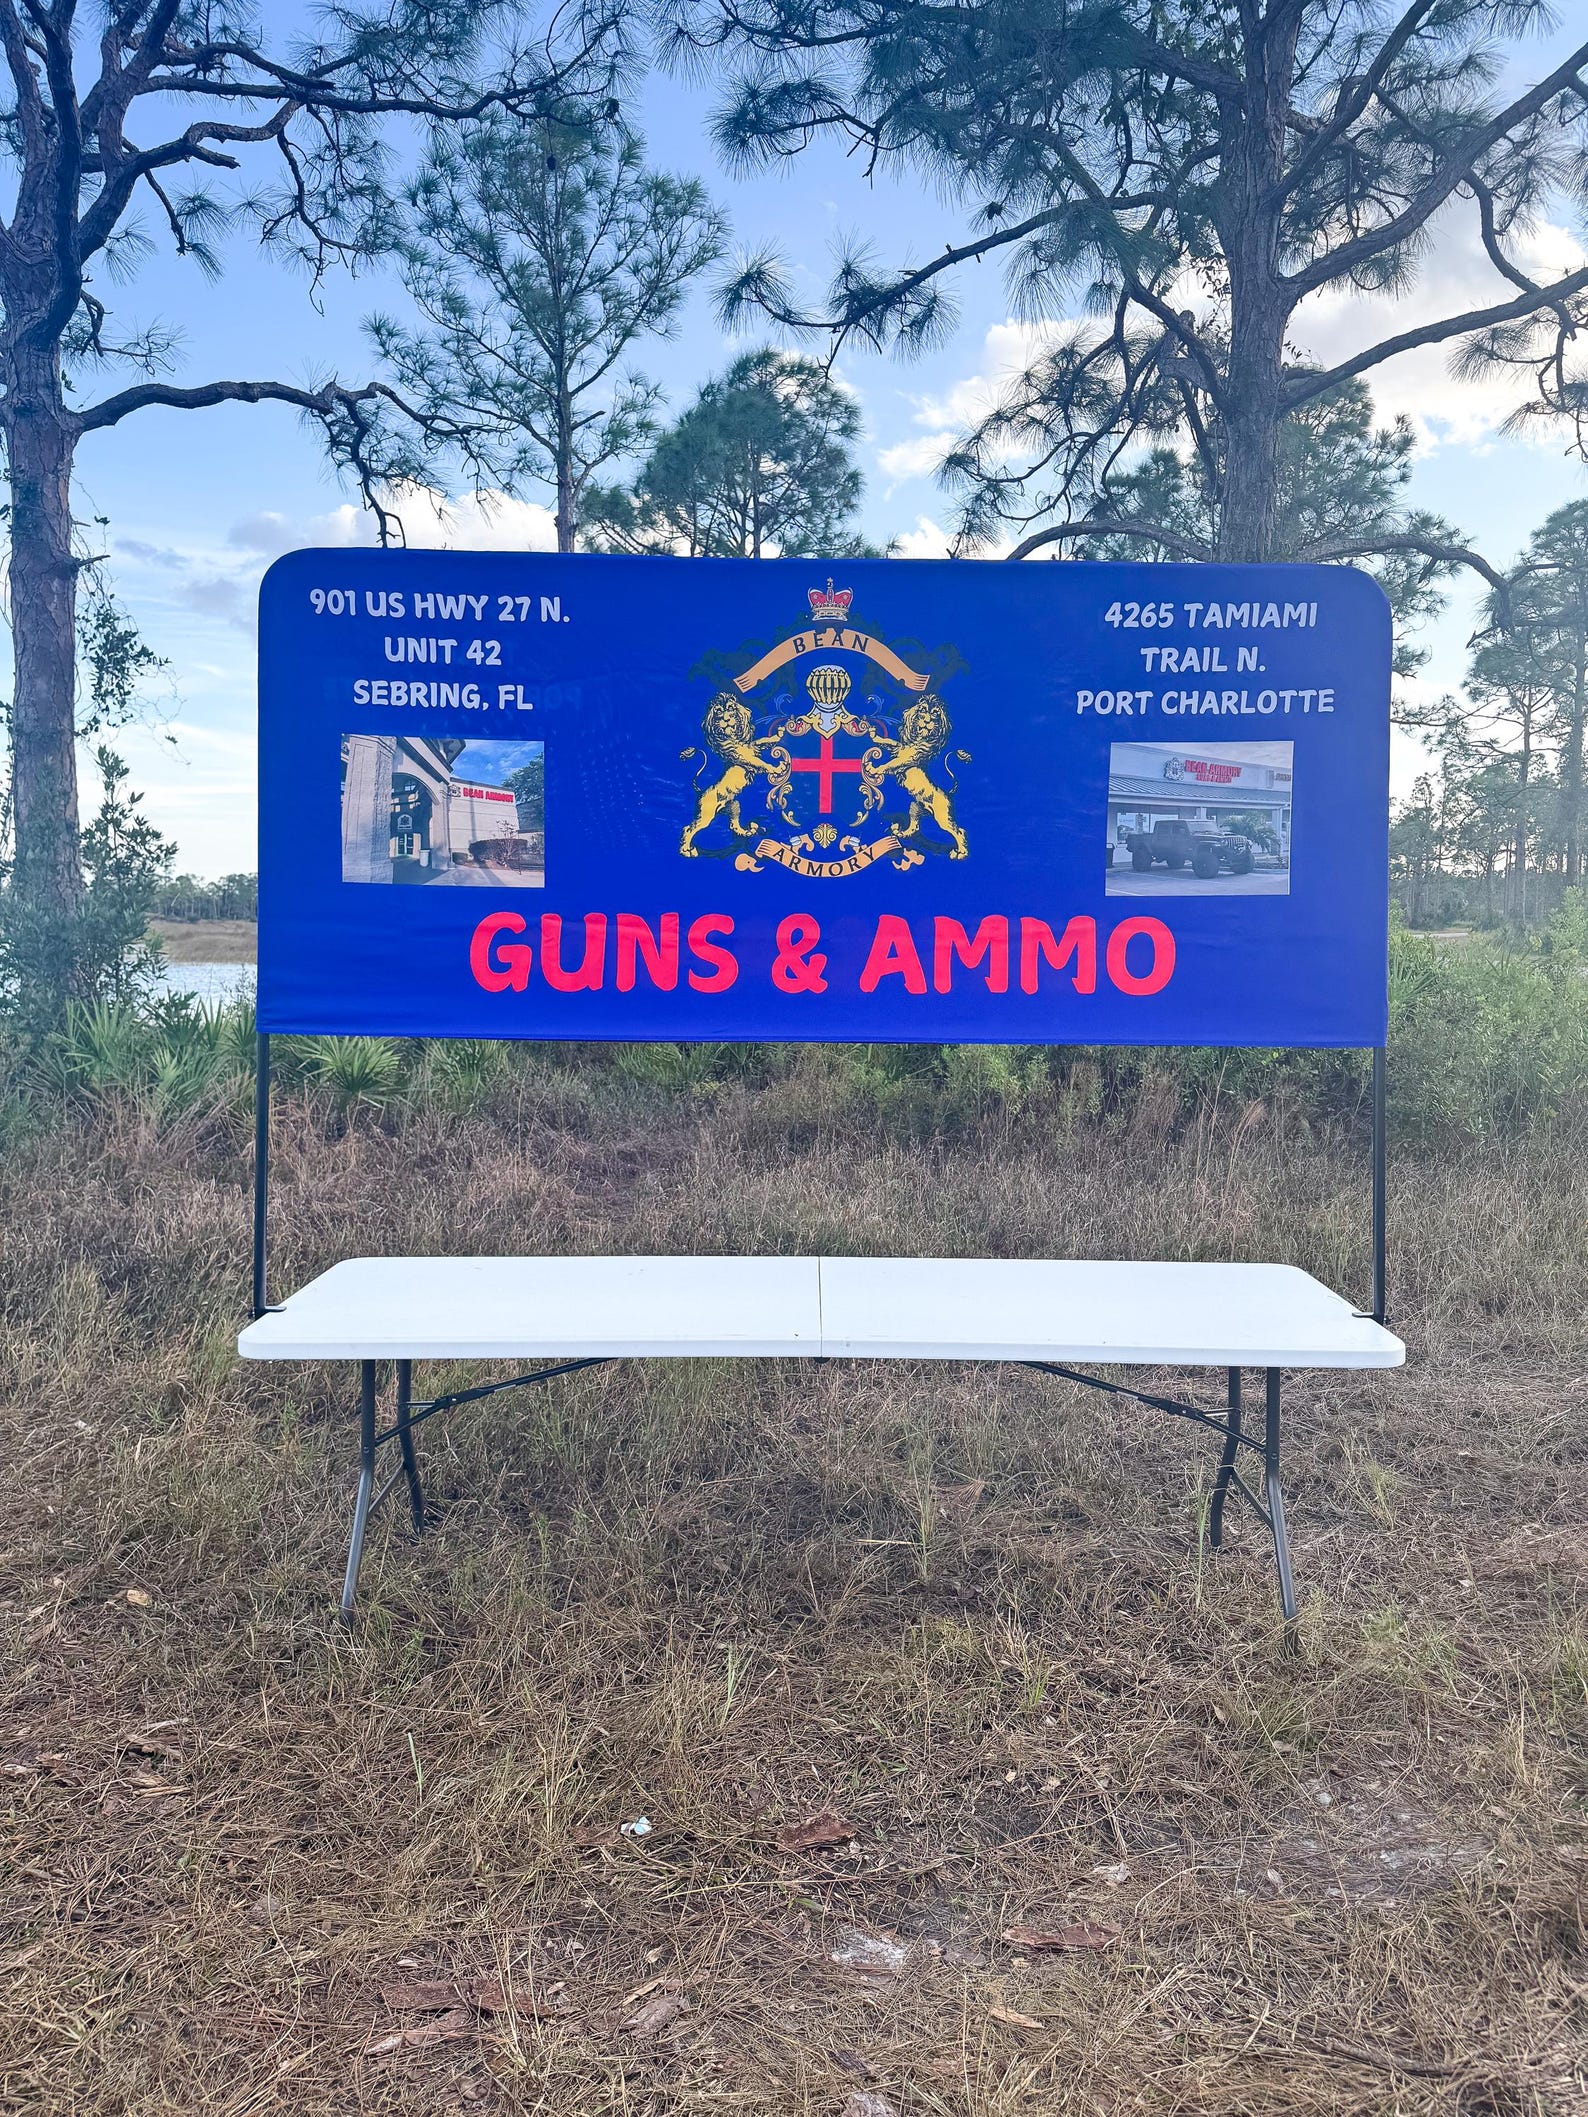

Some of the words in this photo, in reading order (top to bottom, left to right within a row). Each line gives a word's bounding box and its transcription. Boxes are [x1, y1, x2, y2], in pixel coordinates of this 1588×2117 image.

[309, 588, 356, 616] 901
[365, 591, 406, 618] US
[413, 593, 489, 621] HWY
[497, 595, 531, 622] 27
[540, 596, 570, 623] N.
[1104, 601, 1174, 629] 4265
[1183, 602, 1318, 629] TAMIAMI
[384, 636, 458, 665] UNIT
[466, 639, 502, 666] 42
[793, 630, 869, 654] BEAN
[1140, 646, 1228, 673] TRAIL
[1236, 646, 1266, 673] N.
[353, 679, 489, 711] SEBRING,
[498, 684, 534, 710] FL
[1076, 690, 1154, 716] PORT
[1161, 688, 1335, 715] CHARLOTTE
[773, 847, 874, 877] ARMORY
[469, 911, 739, 994] GUNS
[771, 913, 829, 994] &
[859, 914, 1177, 996] AMMO
